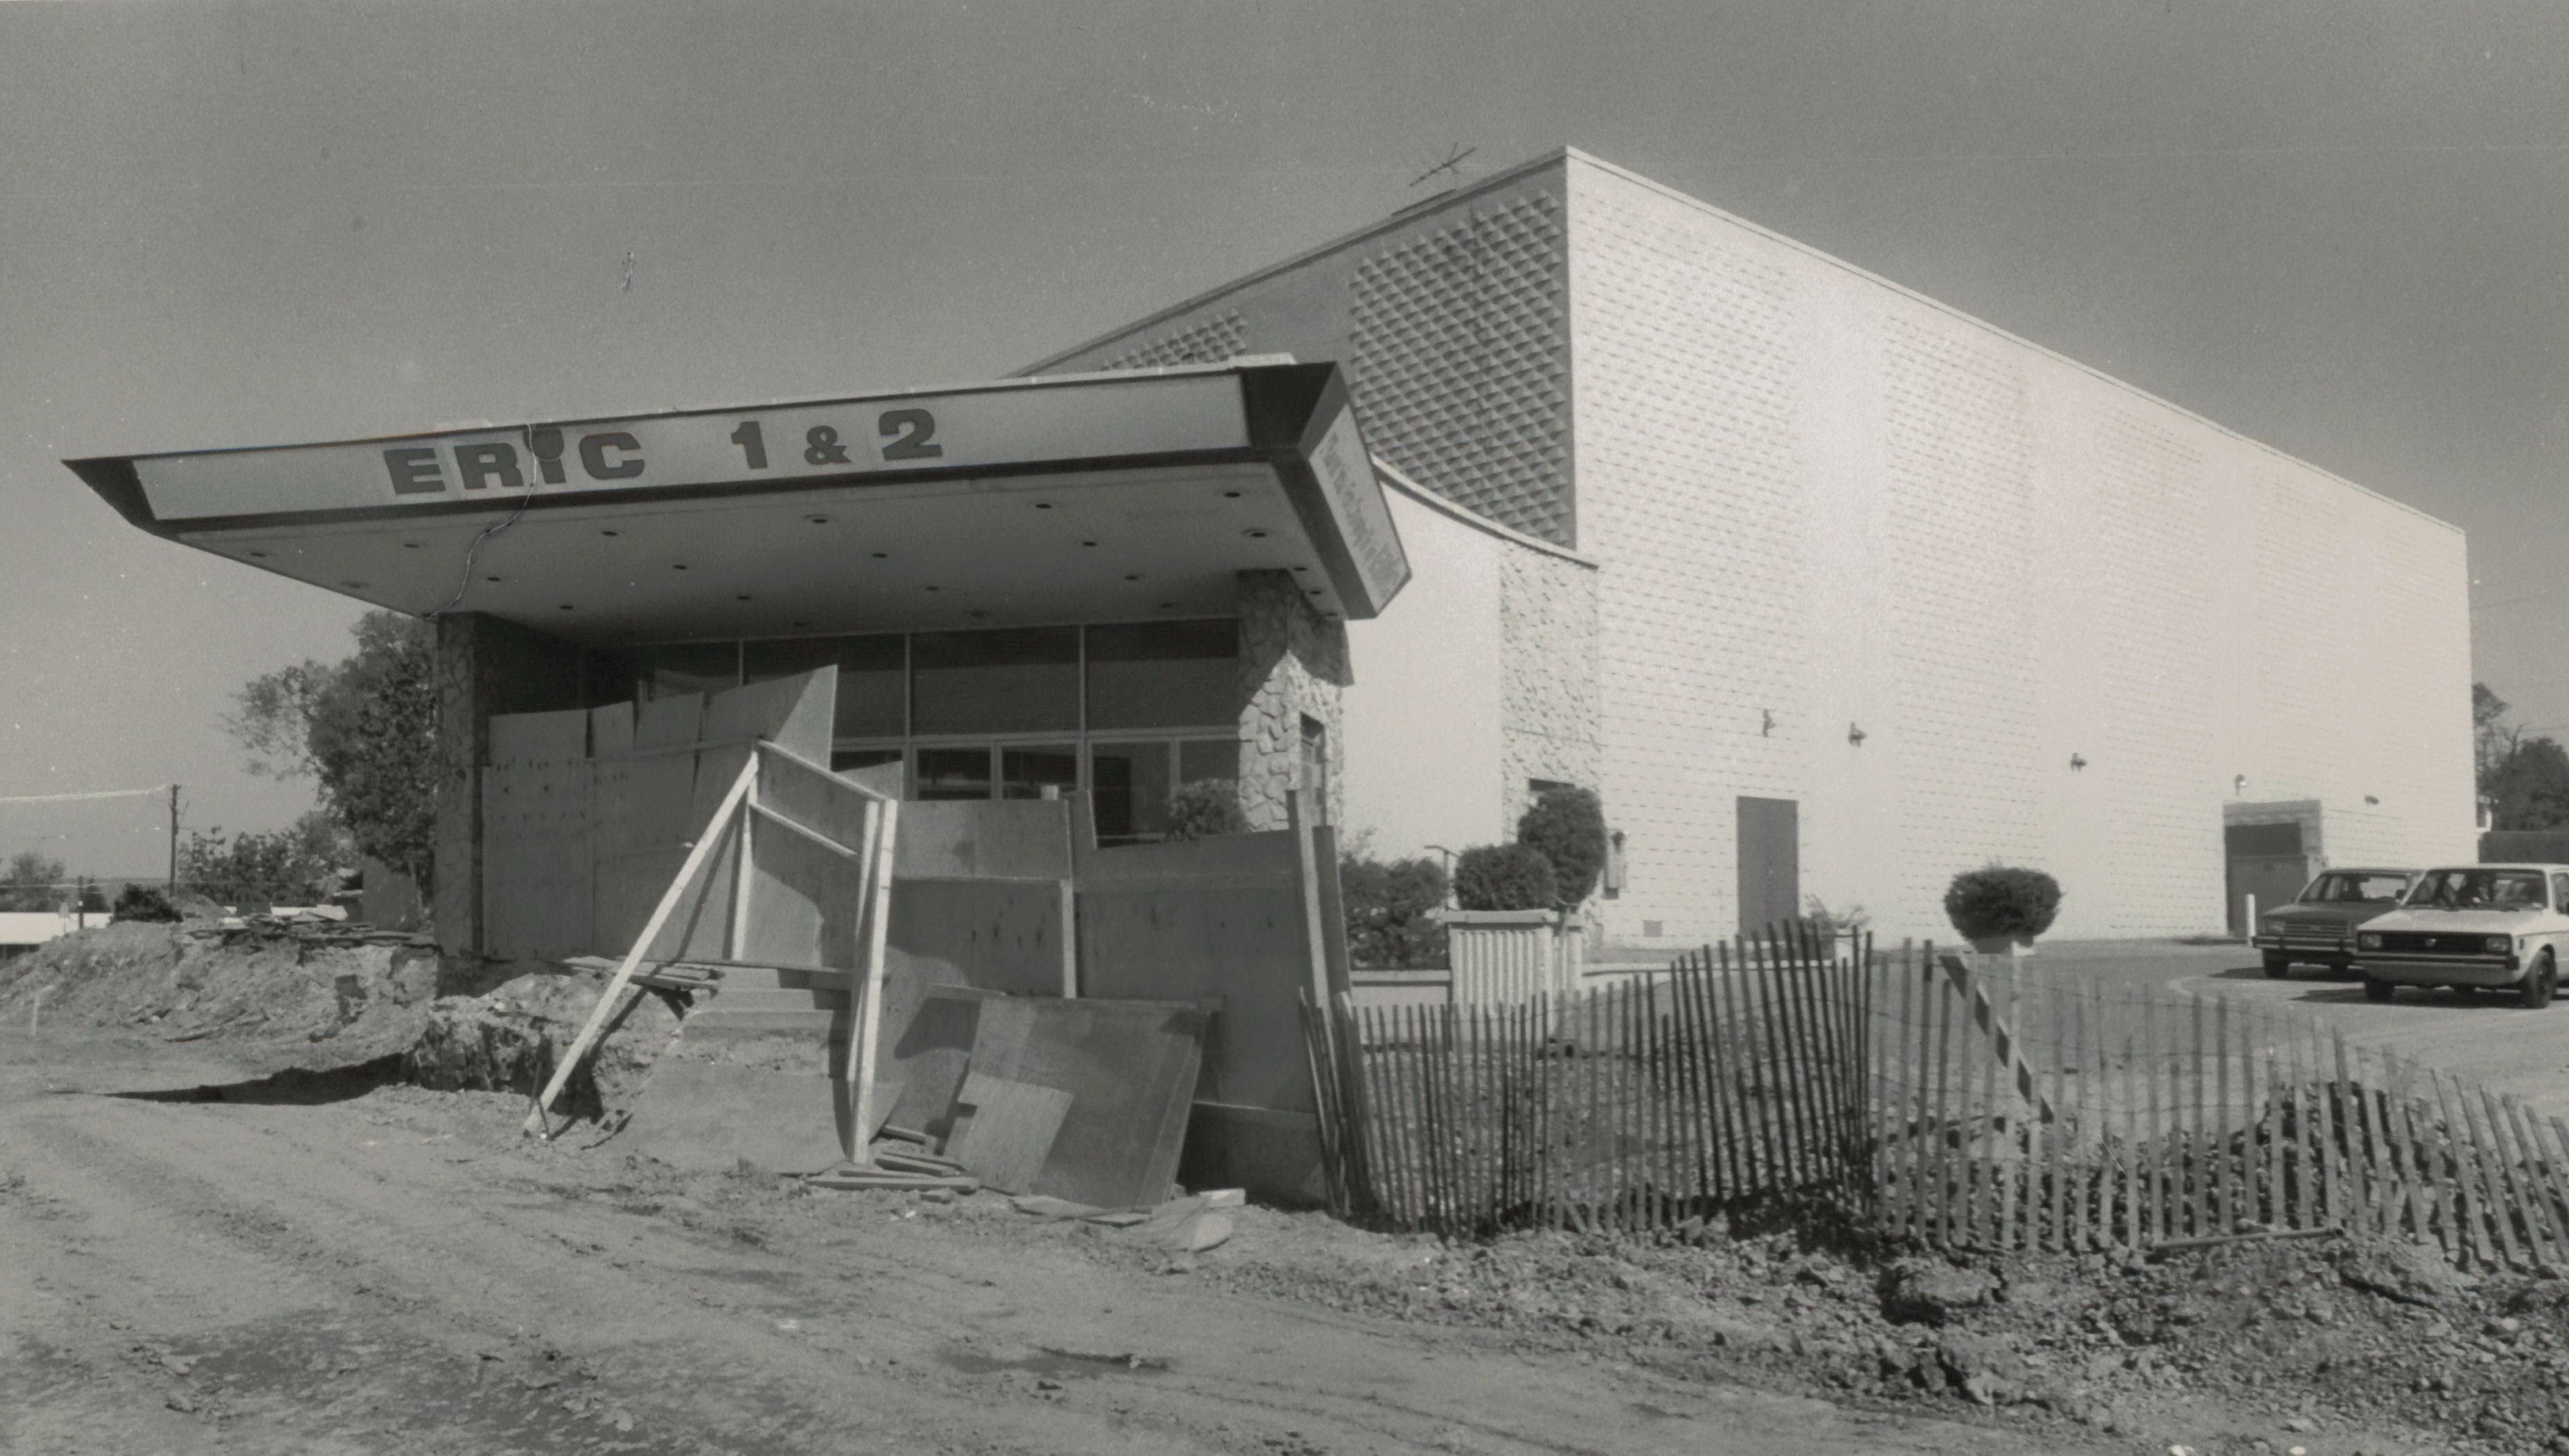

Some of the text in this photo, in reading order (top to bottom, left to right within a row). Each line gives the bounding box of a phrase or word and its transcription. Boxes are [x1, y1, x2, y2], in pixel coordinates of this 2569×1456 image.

[731, 421, 769, 470] 1
[804, 425, 852, 464] &
[878, 408, 943, 461] 2
